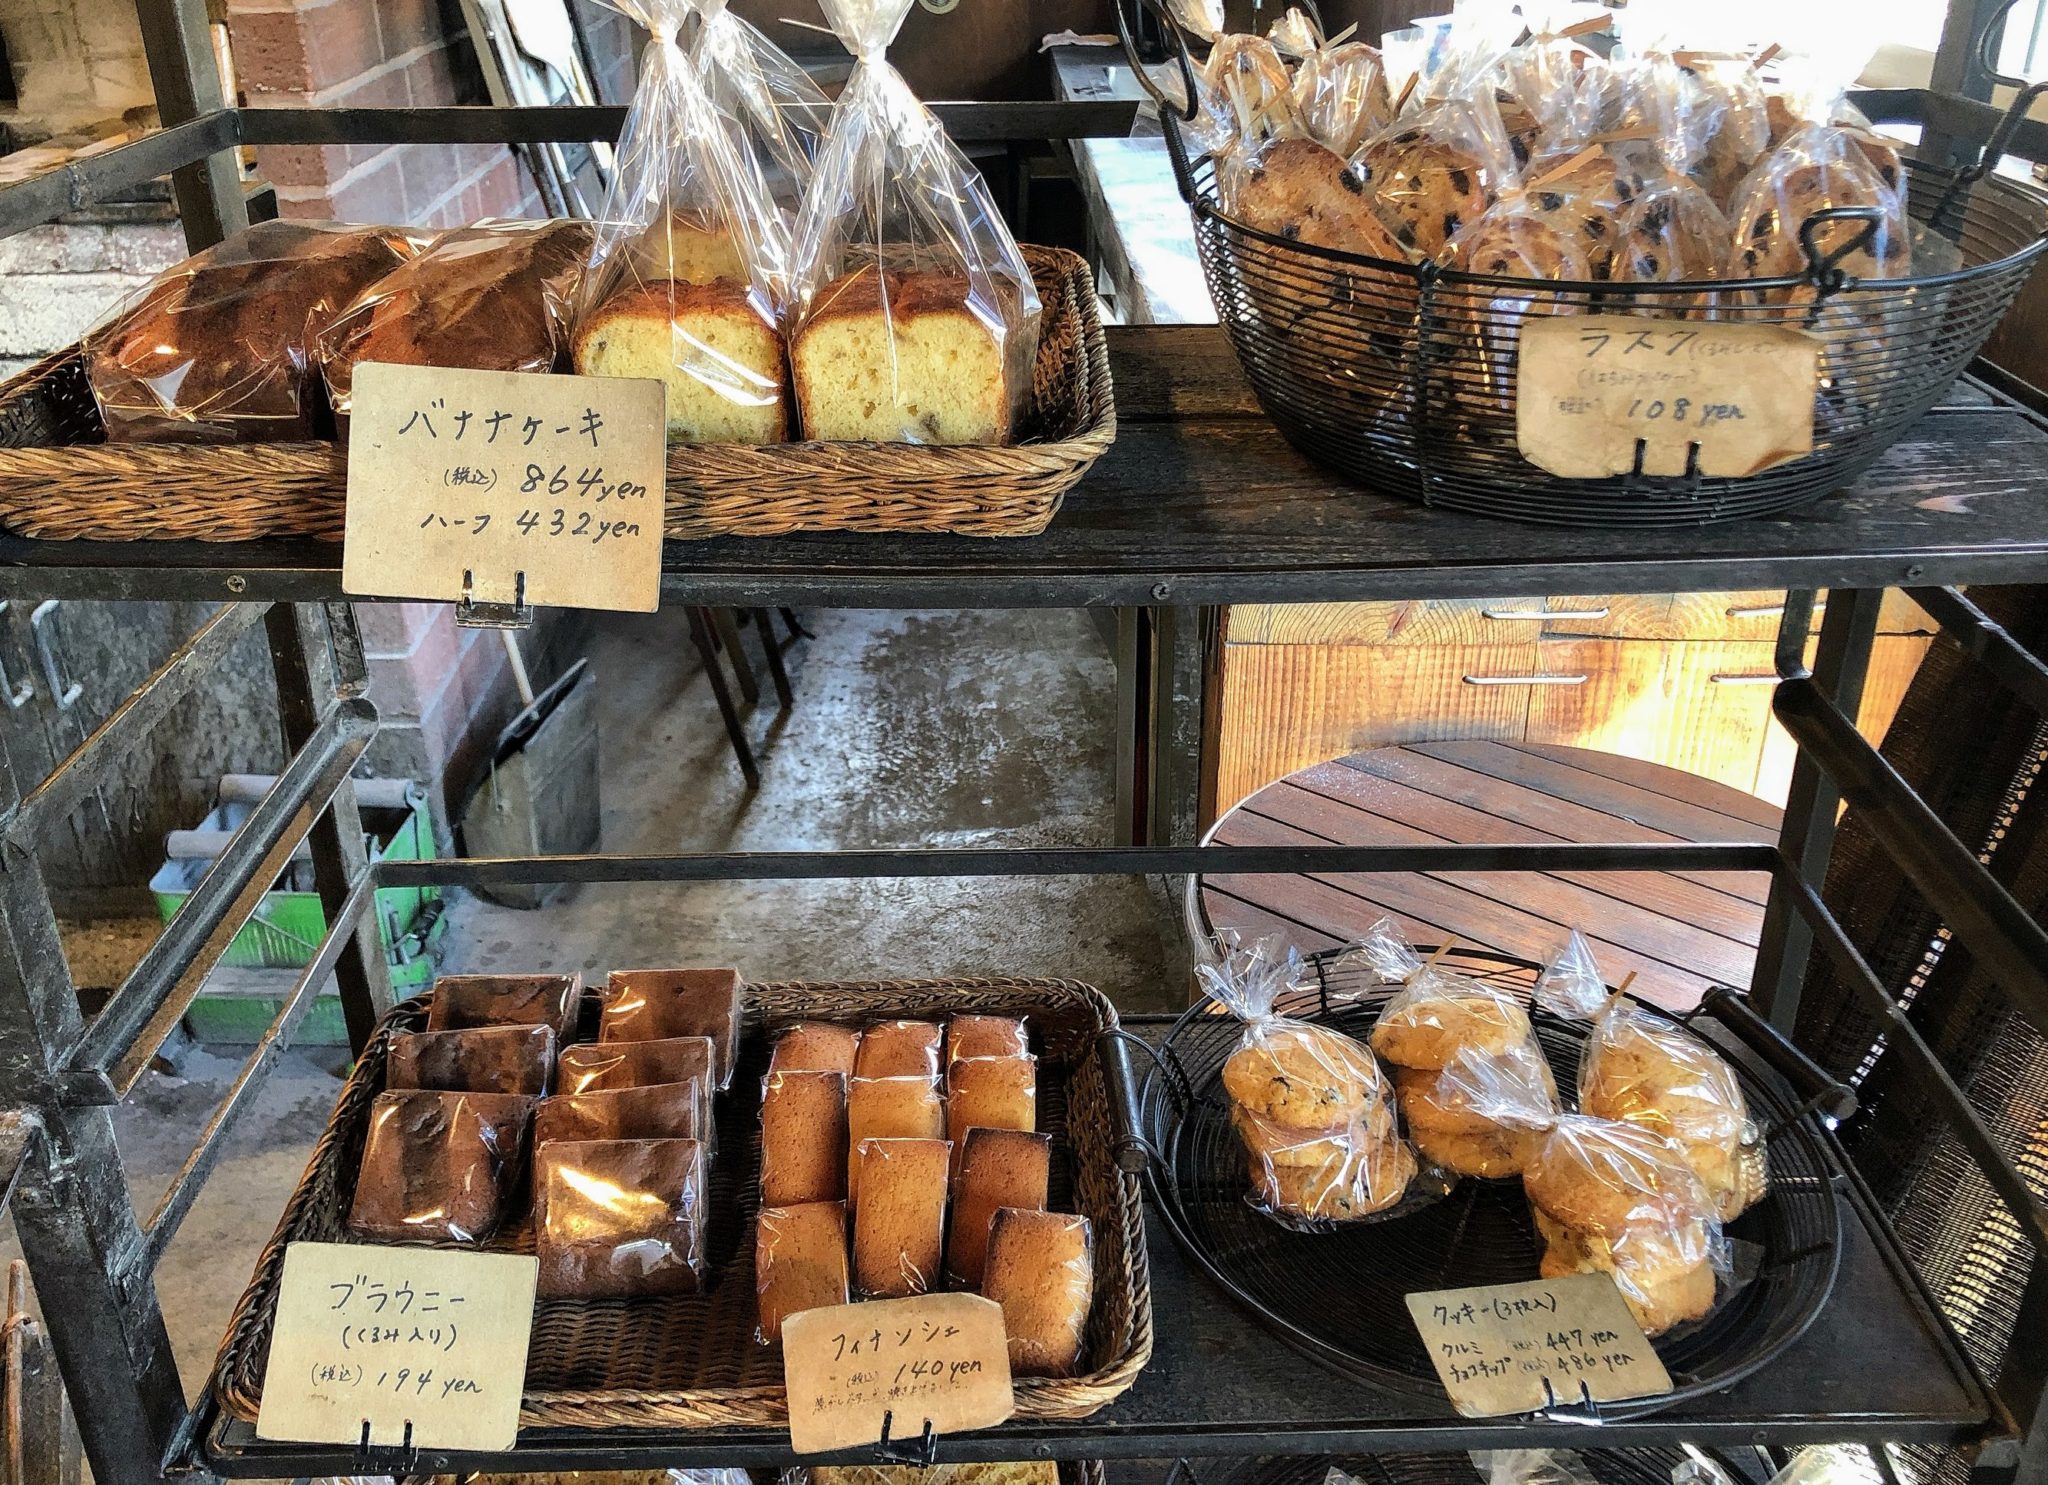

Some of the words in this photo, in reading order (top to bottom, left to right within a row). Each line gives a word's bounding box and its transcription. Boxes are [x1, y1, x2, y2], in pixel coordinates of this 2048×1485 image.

[398, 398, 603, 447] バナナケーキ
[1628, 398, 1692, 421] 108
[443, 467, 498, 493] (税込)
[420, 513, 490, 534] ハーフ
[330, 1274, 465, 1313] ブラウニー
[342, 1324, 457, 1351] (くるみ入り)
[1441, 1341, 1484, 1357] クルミ
[311, 1363, 363, 1386] (税込)
[1449, 1357, 1511, 1383] チョコチップ
